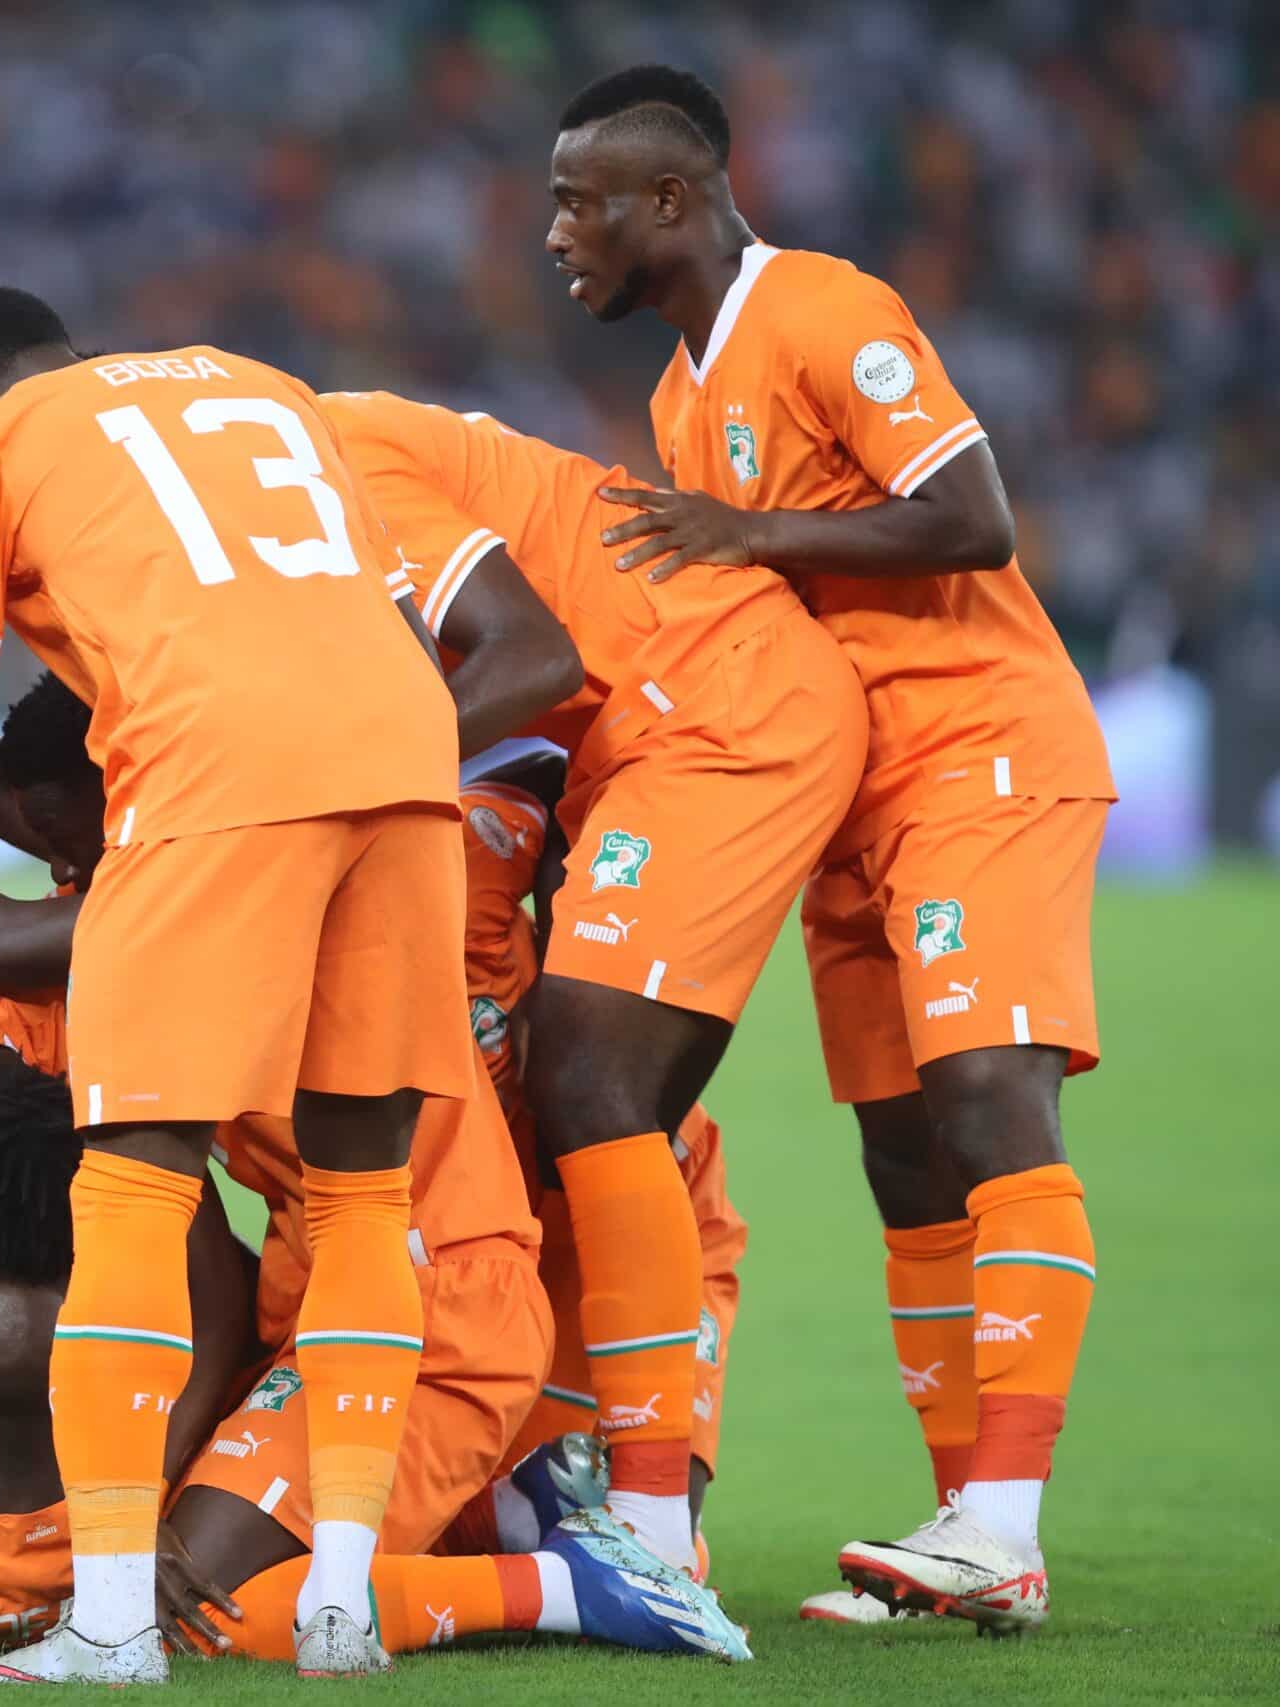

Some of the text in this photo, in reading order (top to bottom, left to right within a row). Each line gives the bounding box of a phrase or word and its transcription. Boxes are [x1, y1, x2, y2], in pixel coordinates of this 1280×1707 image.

[93, 356, 233, 387] BOGA
[95, 397, 361, 586] 13
[573, 919, 621, 945] PUMA
[924, 993, 970, 1020] PUMA
[210, 1438, 251, 1458] PUMA
